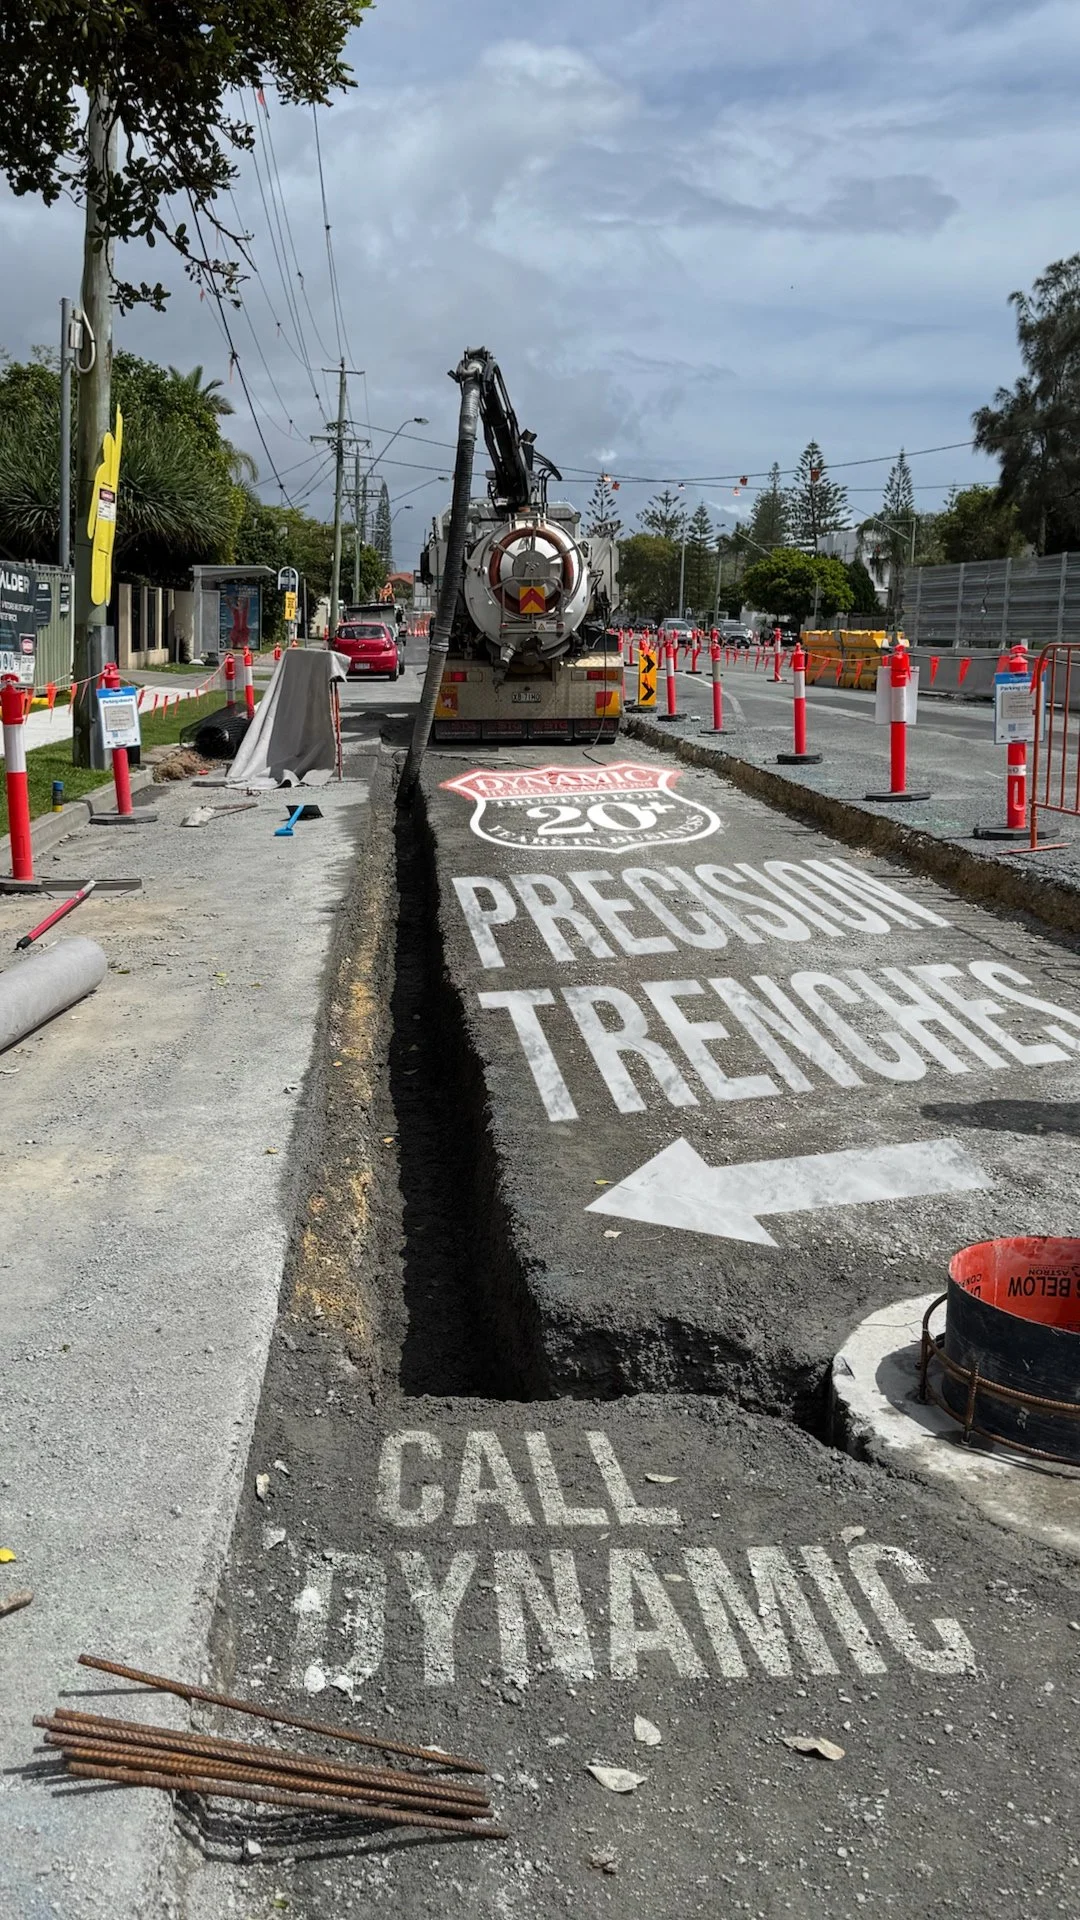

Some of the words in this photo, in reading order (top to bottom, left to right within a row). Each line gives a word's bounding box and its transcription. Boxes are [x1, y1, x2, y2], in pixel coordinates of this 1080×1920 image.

[476, 769, 652, 791] DYNAMIC
[495, 795, 606, 807] TRUSTED
[611, 791, 662, 801] FOR
[488, 825, 566, 846] YEARS
[572, 837, 602, 846] IN
[610, 814, 704, 844] BUSINESS
[526, 801, 676, 836] 20+
[451, 858, 953, 969] PRECISION
[478, 961, 1080, 1122] TRENCHES
[1007, 1276, 1070, 1298] BELOW
[1029, 1268, 1068, 1277] ASTRON
[377, 1430, 682, 1527] CALL
[290, 1543, 978, 1688] DYNAMIC
